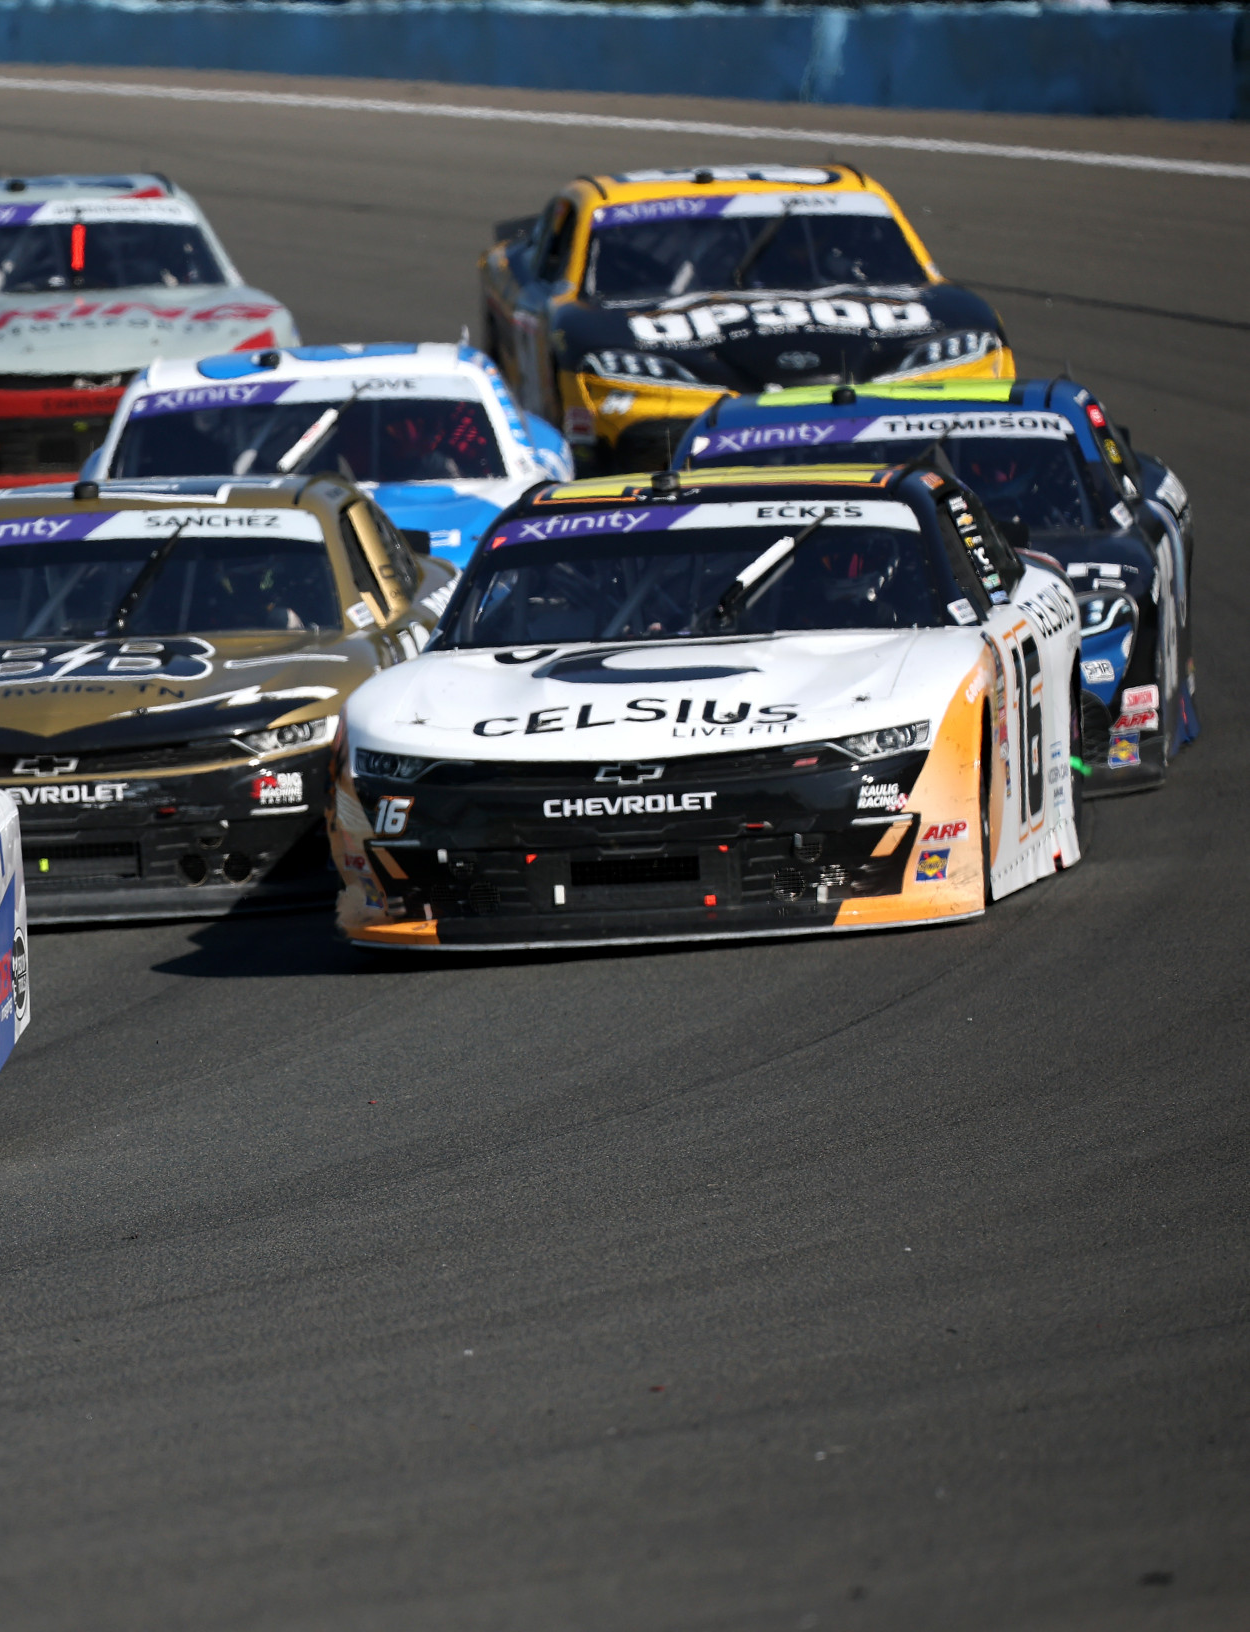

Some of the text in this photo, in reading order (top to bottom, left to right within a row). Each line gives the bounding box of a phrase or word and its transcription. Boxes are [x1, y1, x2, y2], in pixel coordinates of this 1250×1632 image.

[352, 377, 418, 392] LOVE
[152, 382, 263, 410] xfinity
[884, 416, 1064, 435] THOMPSON
[716, 423, 836, 453] xfinity
[145, 513, 280, 530] SANCHEZ
[756, 505, 863, 520] ECKES
[518, 511, 650, 541] xfinity
[131, 682, 186, 699] TN
[472, 697, 801, 738] CELSIUS
[671, 725, 735, 739] LIVE
[6, 782, 129, 806] EVROLET
[860, 783, 900, 797] KAULIG
[542, 791, 718, 818] CHEVROLET
[857, 795, 899, 810] RACING
[374, 797, 414, 835] 16
[922, 821, 967, 842] ARP
